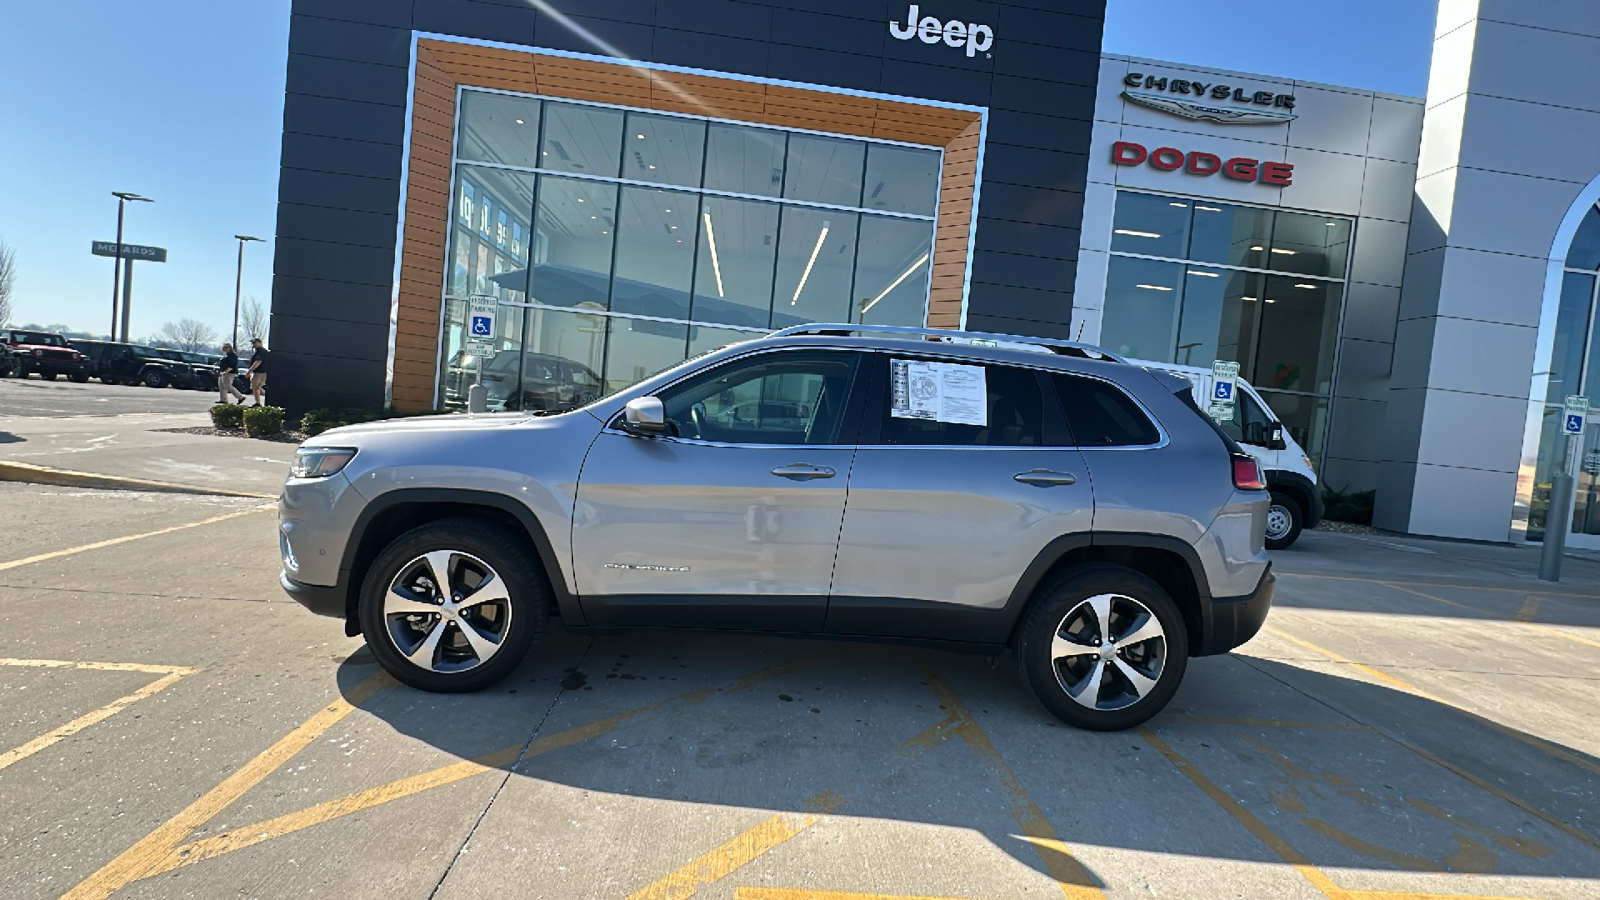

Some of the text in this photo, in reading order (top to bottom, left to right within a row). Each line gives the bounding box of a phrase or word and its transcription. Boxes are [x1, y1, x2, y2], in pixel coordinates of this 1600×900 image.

[889, 4, 994, 58] Jeep
[1123, 72, 1297, 109] CHRYSLER
[1112, 141, 1295, 187] DODGE
[97, 243, 156, 256] MEARDS
[470, 305, 495, 314] PARKING
